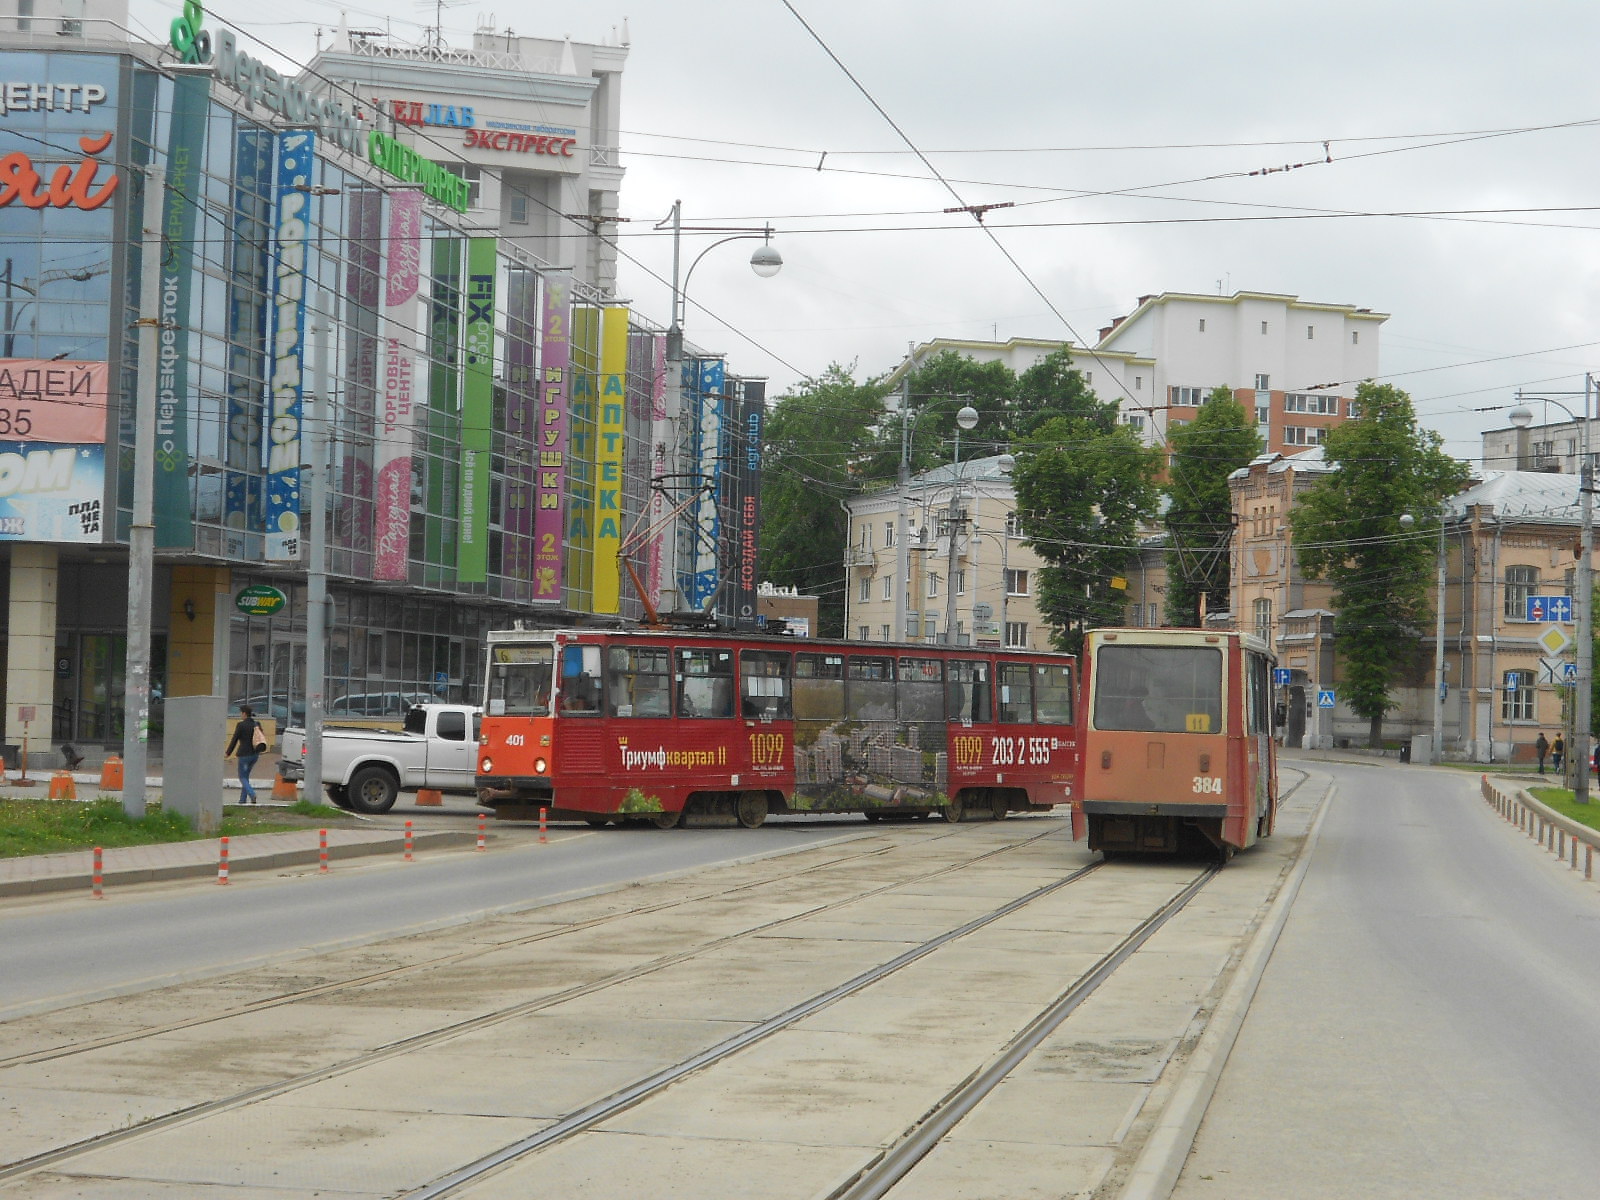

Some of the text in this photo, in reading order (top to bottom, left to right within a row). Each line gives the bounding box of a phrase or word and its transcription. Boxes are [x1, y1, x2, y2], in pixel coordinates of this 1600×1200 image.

[0, 81, 107, 116] ЕНТР
[372, 98, 475, 128] ЕДЛАБ
[463, 129, 577, 158] ЭКСПРЕСС
[368, 130, 470, 214] СУПЕРМАРКЕТ
[165, 147, 190, 273] СУПЕРМАРКЕТ
[468, 274, 493, 325] FIX
[384, 337, 400, 434] ТОРГОВЫЙ
[398, 357, 412, 415] ЦЕНТР
[540, 366, 562, 510] ИГРУШКИ
[598, 375, 623, 539] АПТЕКА
[542, 533, 555, 553] 2
[740, 496, 757, 591] #СОЗДАЙ СЕБЯ
[238, 596, 281, 607] SUBWAY
[506, 735, 524, 747] 401
[749, 733, 784, 764] 1099
[953, 736, 982, 765] 1099
[992, 737, 1014, 765] 203
[1017, 737, 1025, 765] 2
[1029, 737, 1050, 765] 555
[1192, 776, 1222, 795] 384
